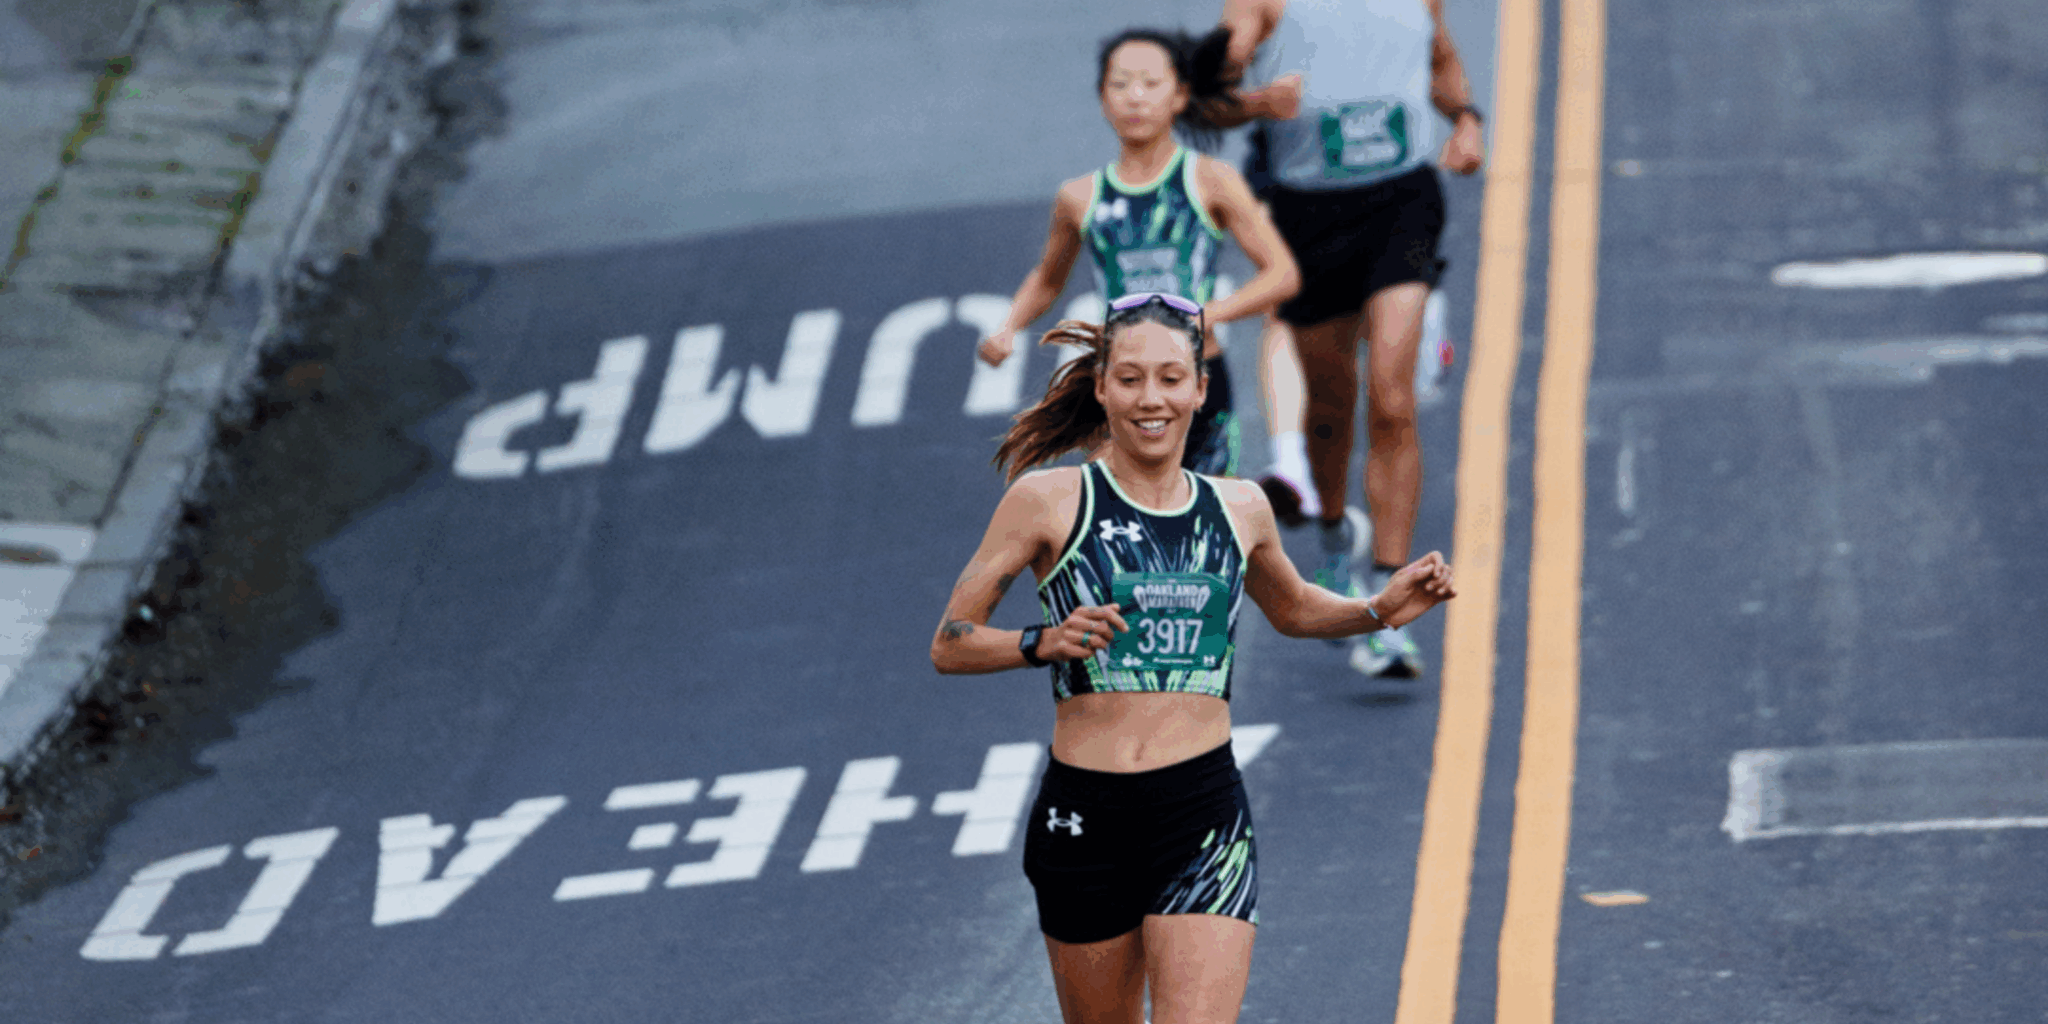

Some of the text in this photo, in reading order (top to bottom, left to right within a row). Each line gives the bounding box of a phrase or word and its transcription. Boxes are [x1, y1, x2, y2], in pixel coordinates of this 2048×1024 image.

[453, 277, 1232, 479] UMP
[1137, 618, 1203, 654] 3917
[1146, 584, 1199, 596] OAKLAND
[80, 724, 1281, 960] HEAD
